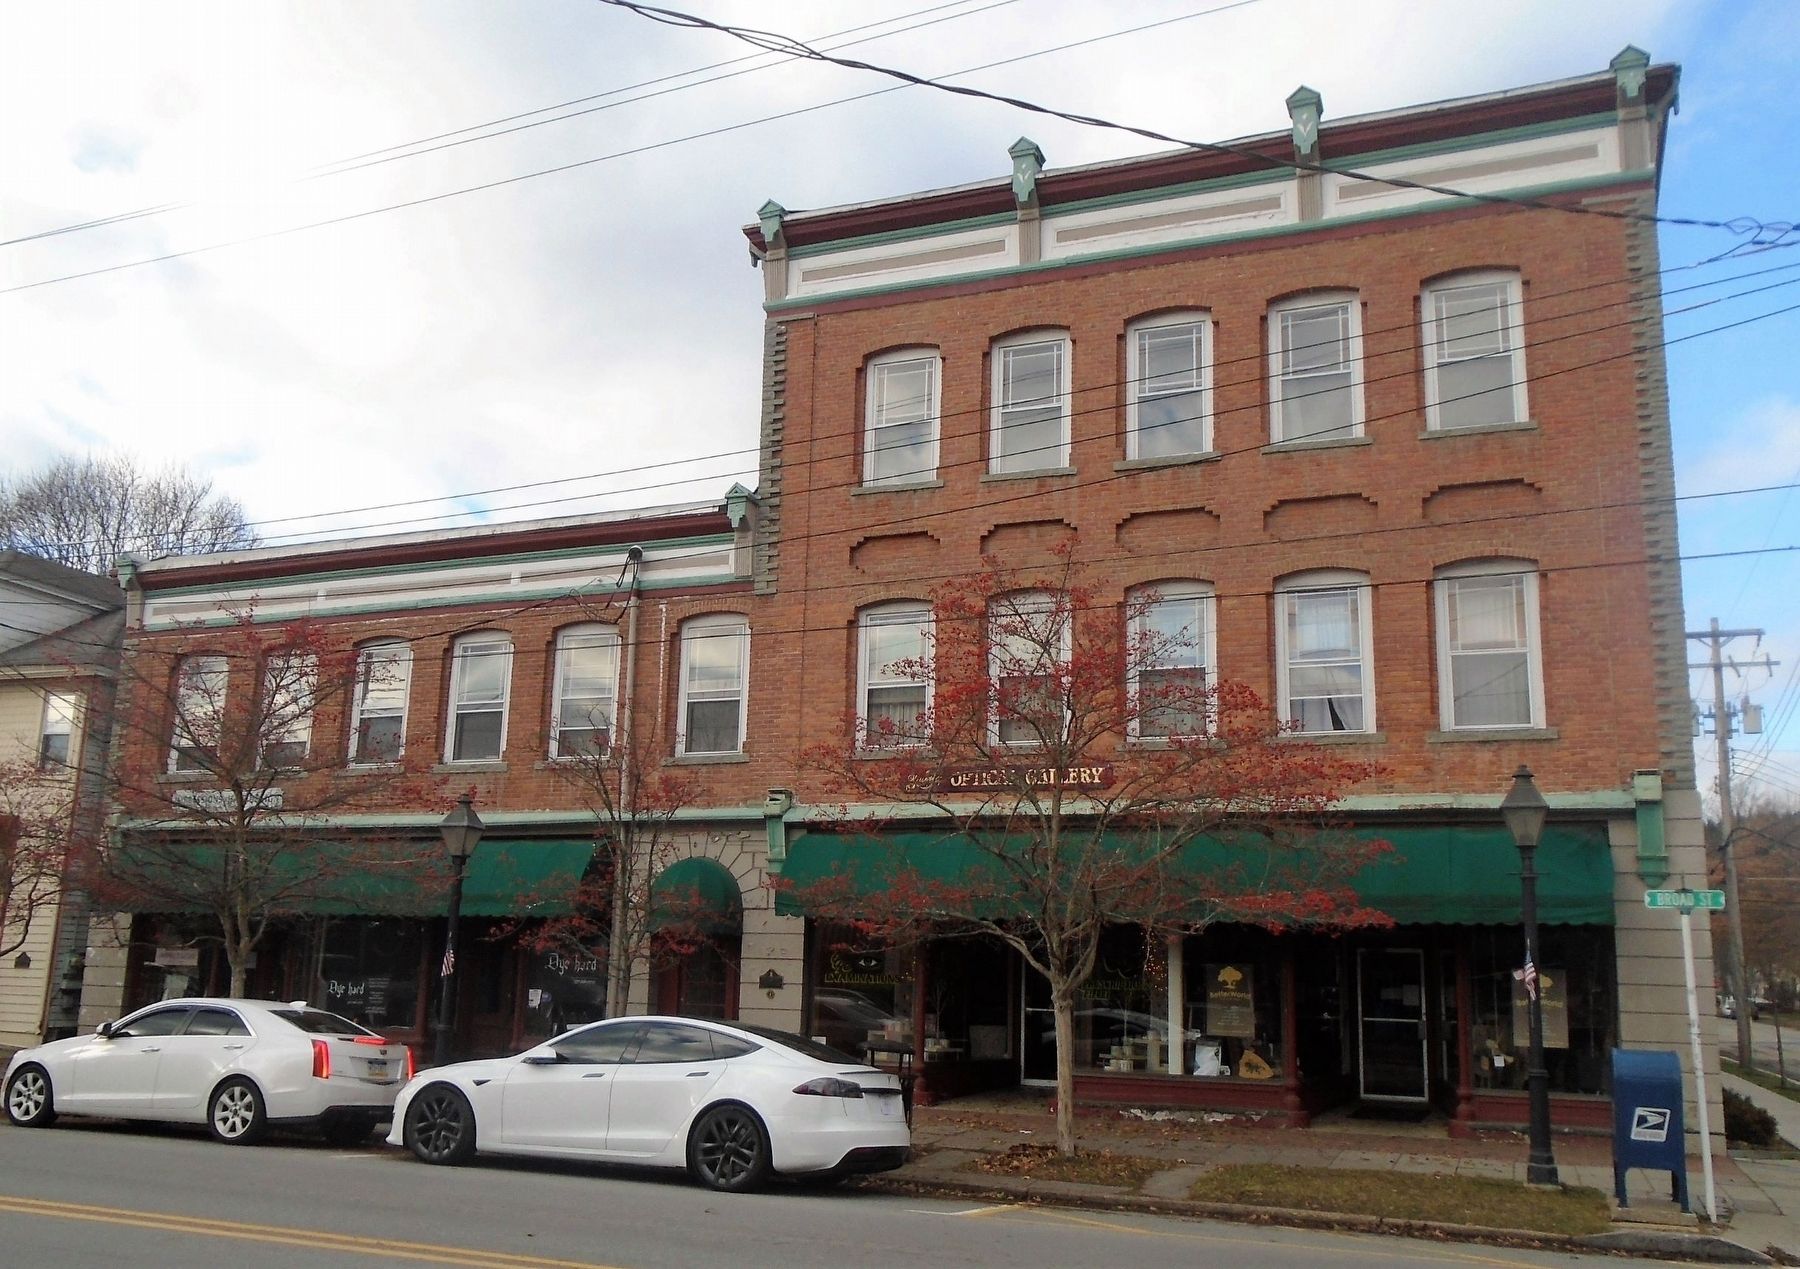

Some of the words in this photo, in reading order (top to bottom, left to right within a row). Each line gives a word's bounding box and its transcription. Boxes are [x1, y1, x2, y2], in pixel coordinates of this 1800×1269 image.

[1657, 892, 1695, 906] BROAD
[1699, 892, 1712, 906] ST
[574, 954, 597, 972] hard
[824, 973, 901, 985] EXAMINATIONS
[348, 981, 365, 996] hard
